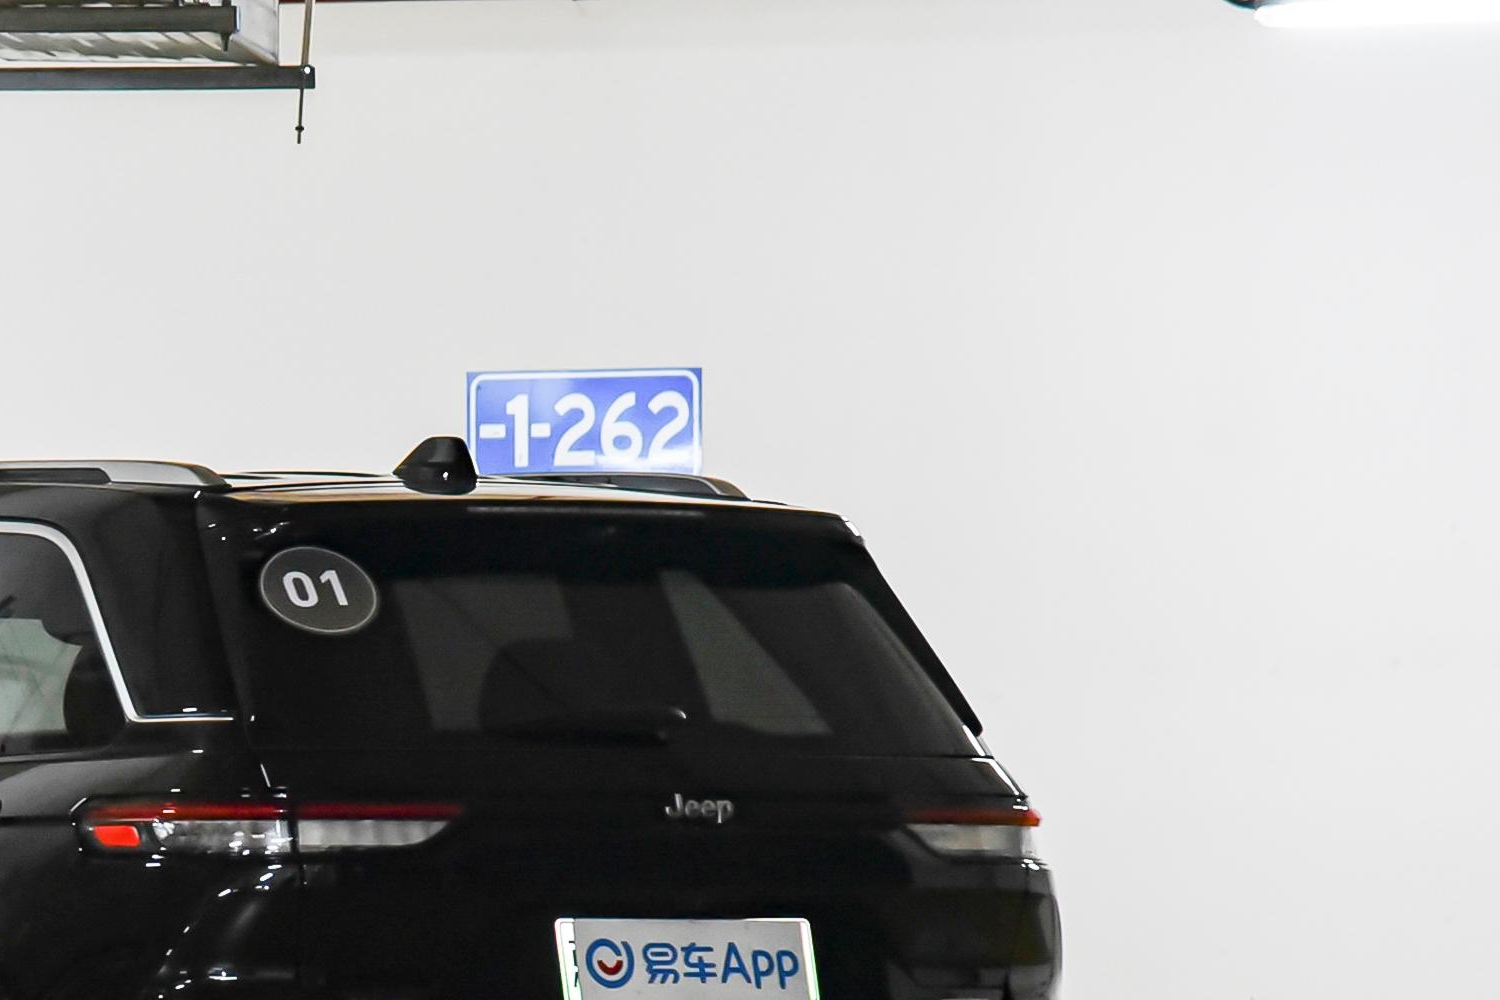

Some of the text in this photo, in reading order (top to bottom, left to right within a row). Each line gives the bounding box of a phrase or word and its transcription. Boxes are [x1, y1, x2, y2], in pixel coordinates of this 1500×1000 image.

[479, 390, 690, 468] -1-262
[282, 570, 349, 608] 01
[664, 792, 734, 824] Jeep
[641, 941, 799, 990] 易车App
